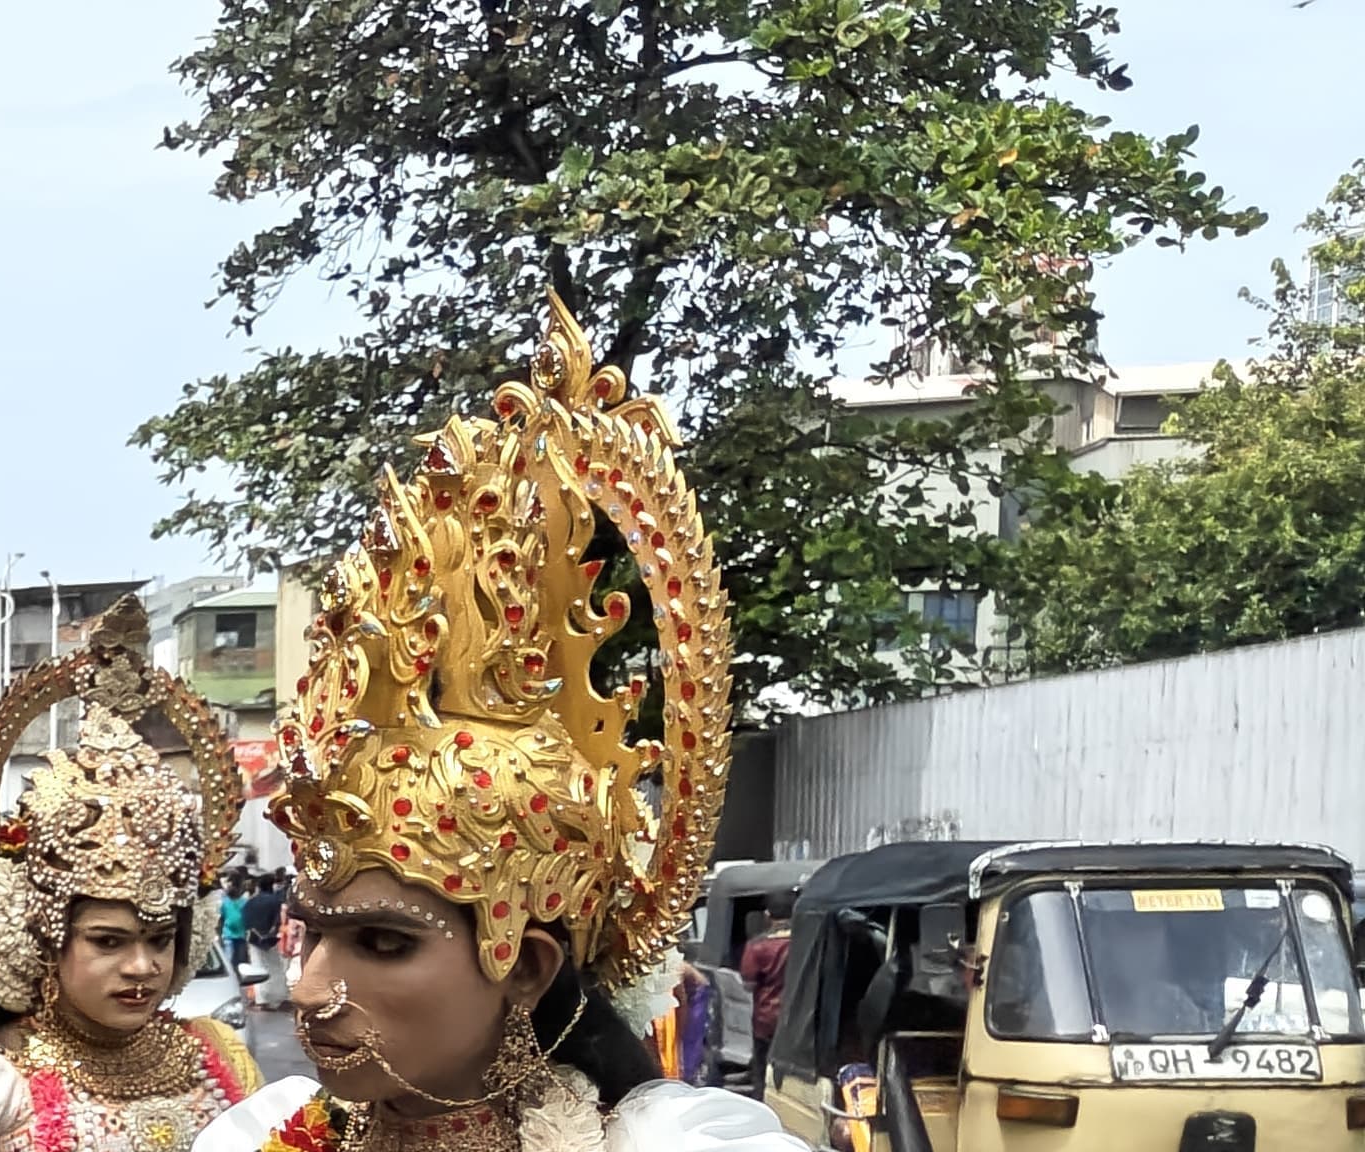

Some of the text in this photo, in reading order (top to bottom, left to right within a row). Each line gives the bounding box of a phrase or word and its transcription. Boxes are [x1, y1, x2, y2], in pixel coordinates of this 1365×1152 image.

[1137, 894, 1219, 908] METER TAXI
[1149, 1048, 1196, 1075] QH
[1231, 1048, 1317, 1078] 9482
